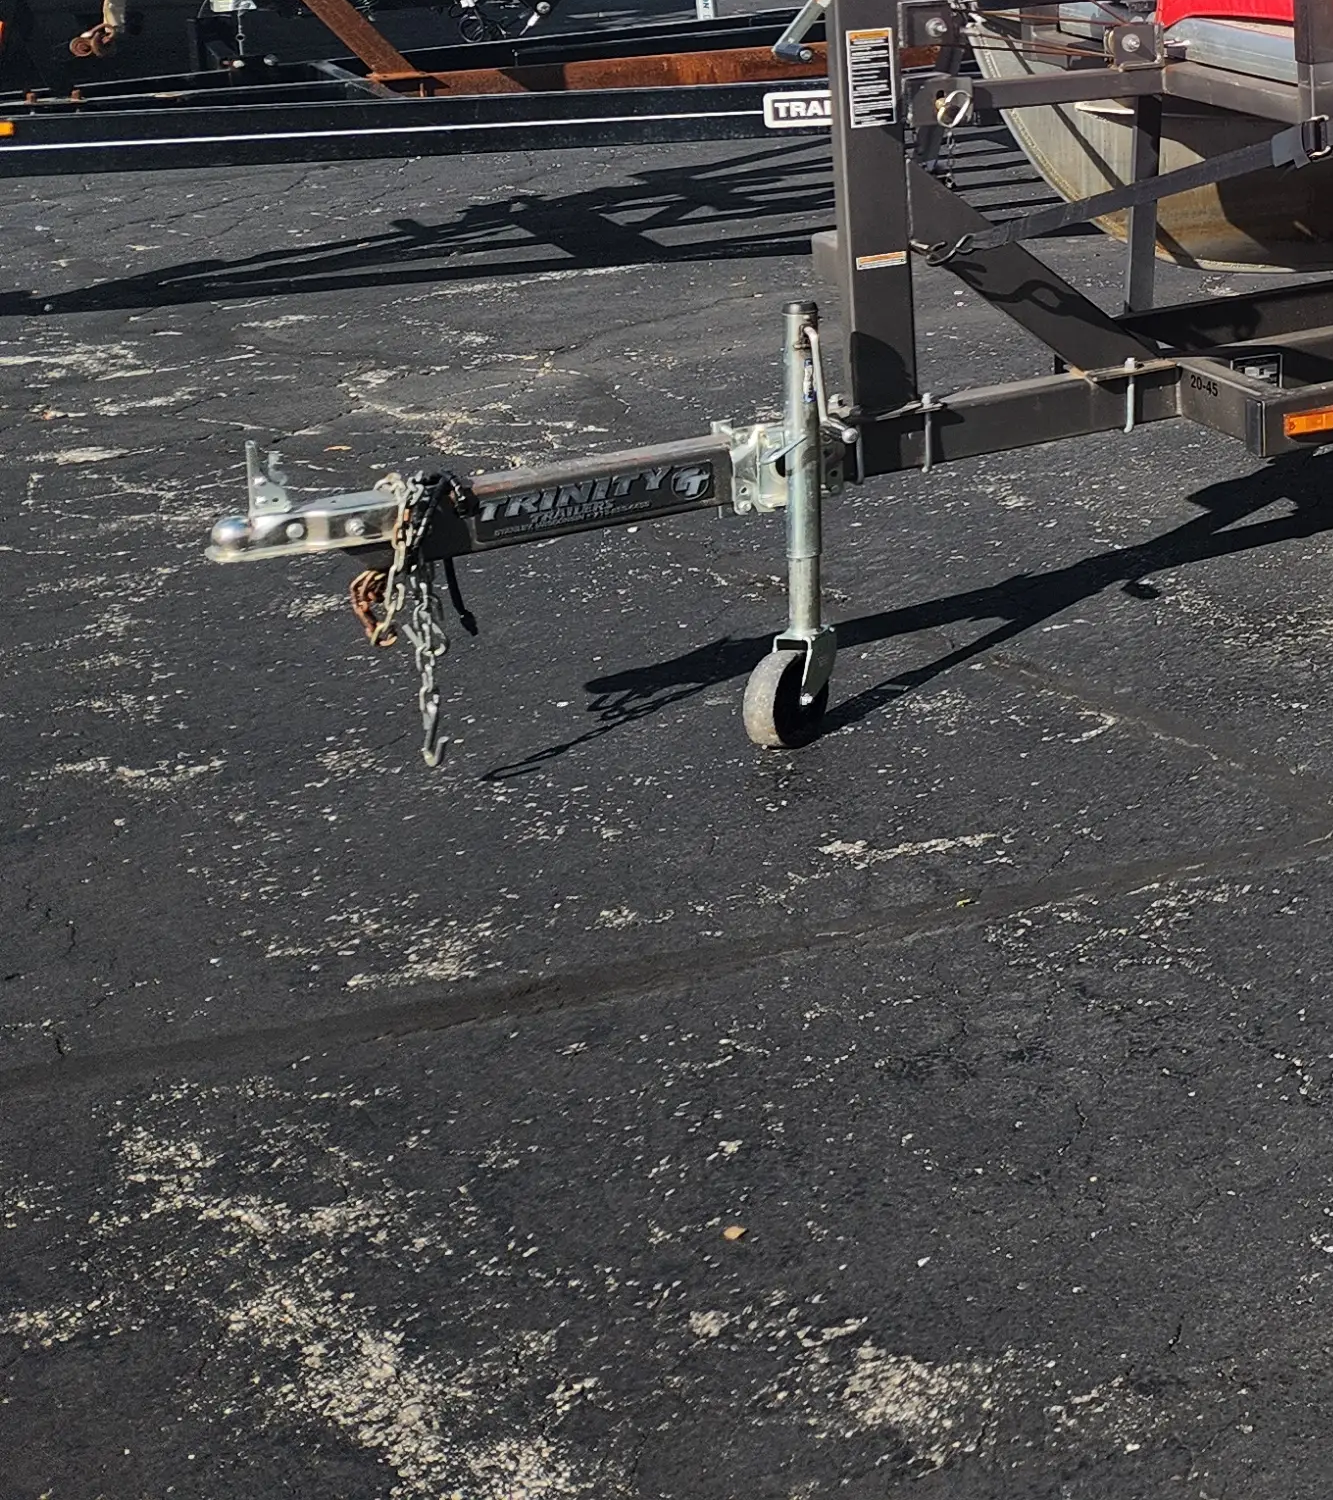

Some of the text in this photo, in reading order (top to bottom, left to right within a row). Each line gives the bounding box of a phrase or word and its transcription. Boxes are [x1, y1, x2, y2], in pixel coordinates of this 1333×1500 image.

[1190, 374, 1219, 397] 20-45
[479, 465, 672, 522] TRINITY
[529, 499, 616, 524] TRAILERS
